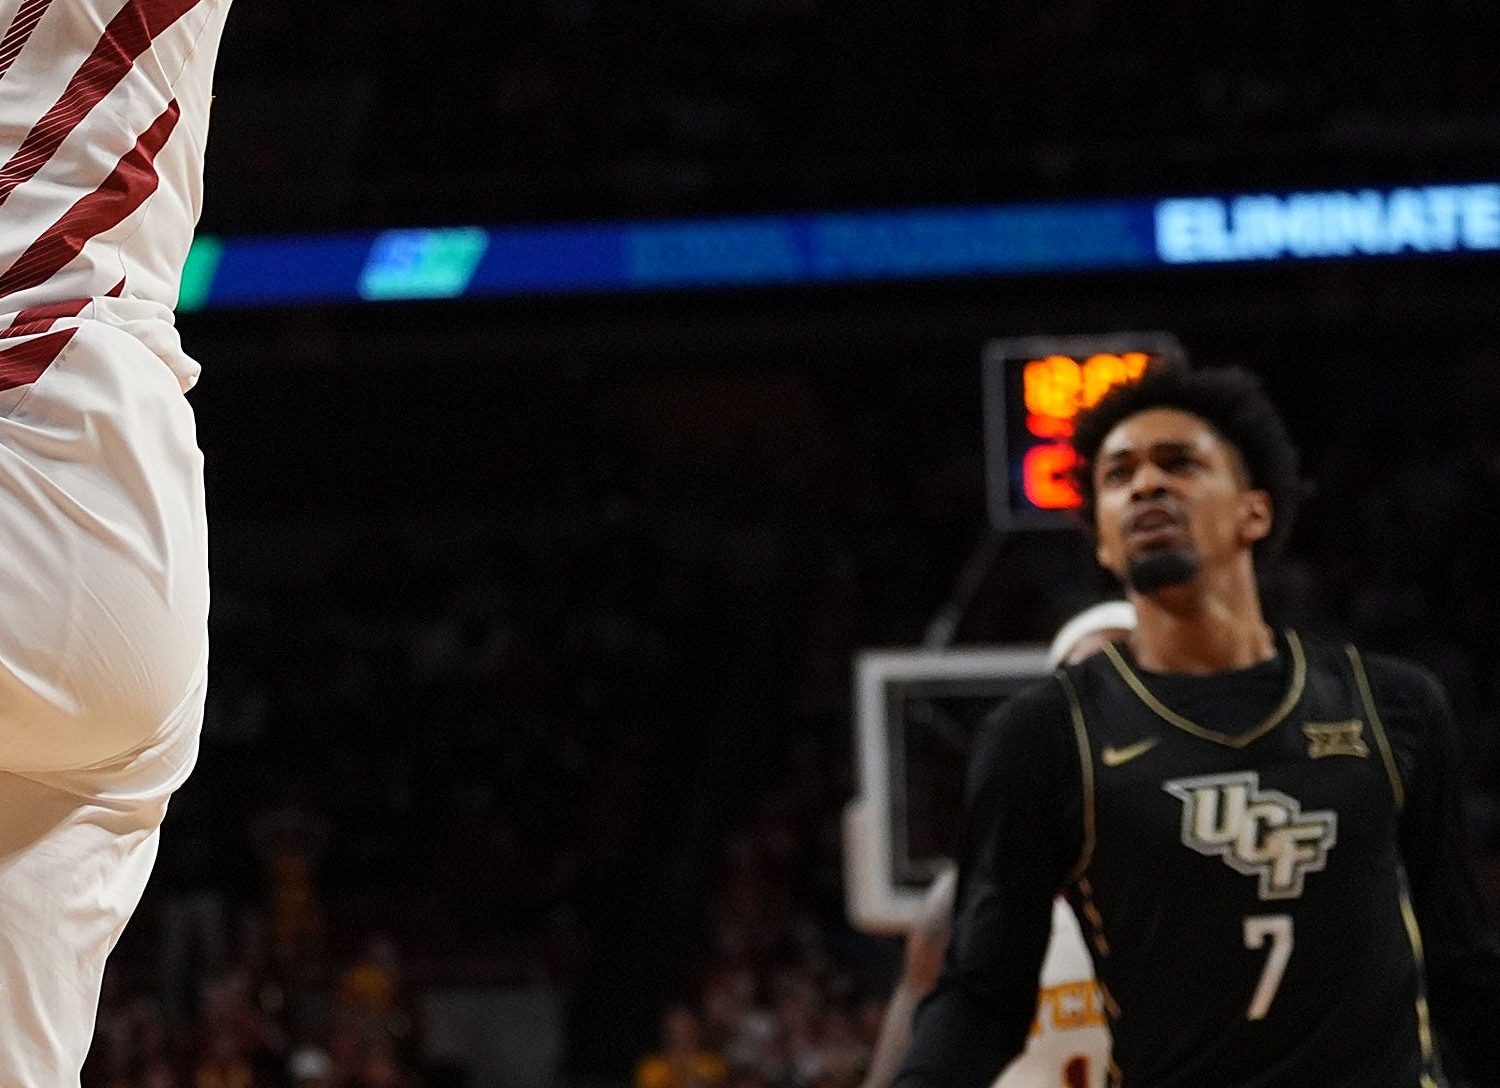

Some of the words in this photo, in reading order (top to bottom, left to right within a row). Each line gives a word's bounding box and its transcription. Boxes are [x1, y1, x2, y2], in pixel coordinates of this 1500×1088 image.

[1156, 183, 1500, 263] ELIMINATE
[1163, 771, 1338, 900] UCF
[1243, 914, 1295, 1020] 7
